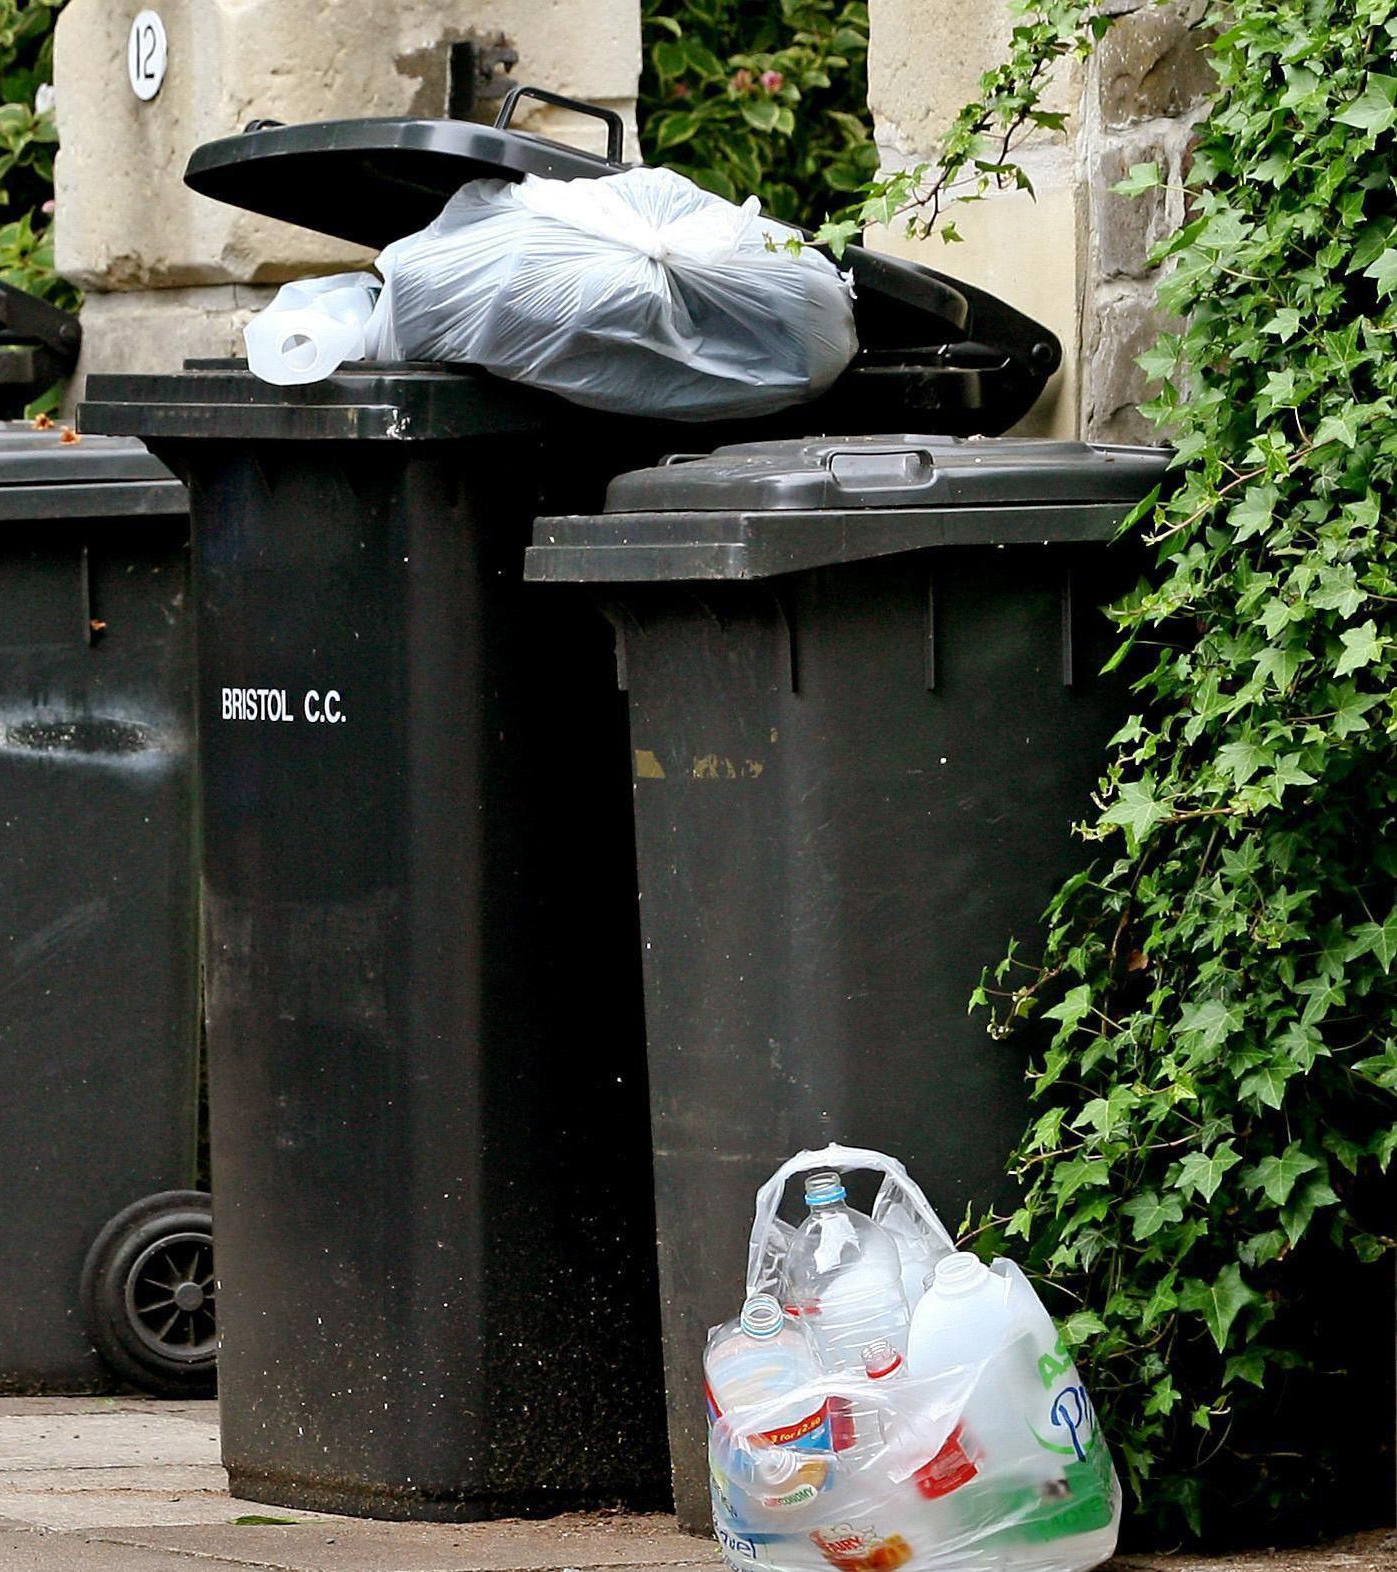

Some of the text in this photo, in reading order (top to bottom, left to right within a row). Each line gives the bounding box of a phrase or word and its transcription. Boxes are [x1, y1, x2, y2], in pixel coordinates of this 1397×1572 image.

[136, 26, 156, 80] 12
[222, 688, 346, 723] BRISTOL C.C.
[780, 1431, 795, 1441] for
